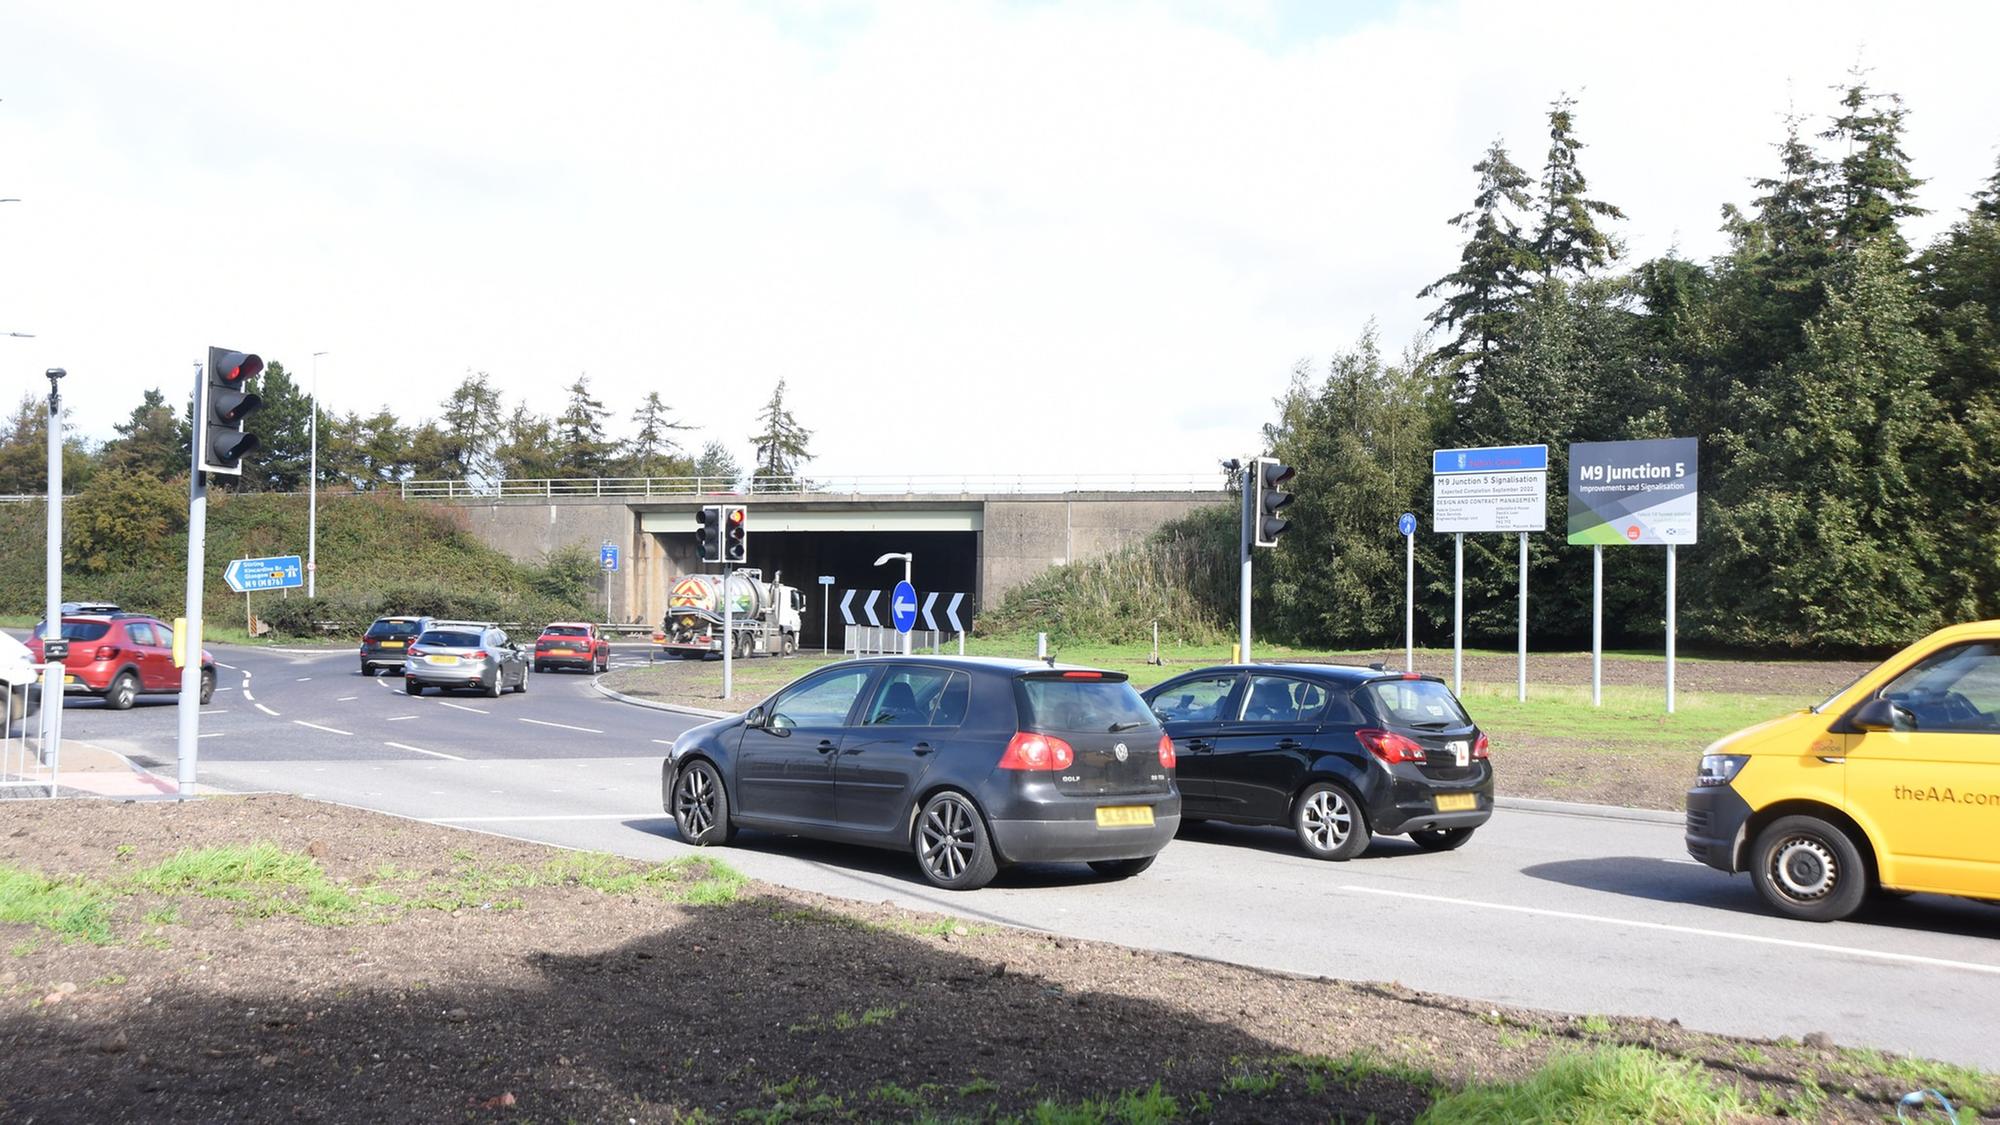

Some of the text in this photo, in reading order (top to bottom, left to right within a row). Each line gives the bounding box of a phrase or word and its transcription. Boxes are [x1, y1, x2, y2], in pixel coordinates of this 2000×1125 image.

[1580, 462, 1685, 484] M9 Junction 5
[1491, 476, 1538, 485] Signalisation
[1579, 482, 1685, 493] Improvements and Signalisation
